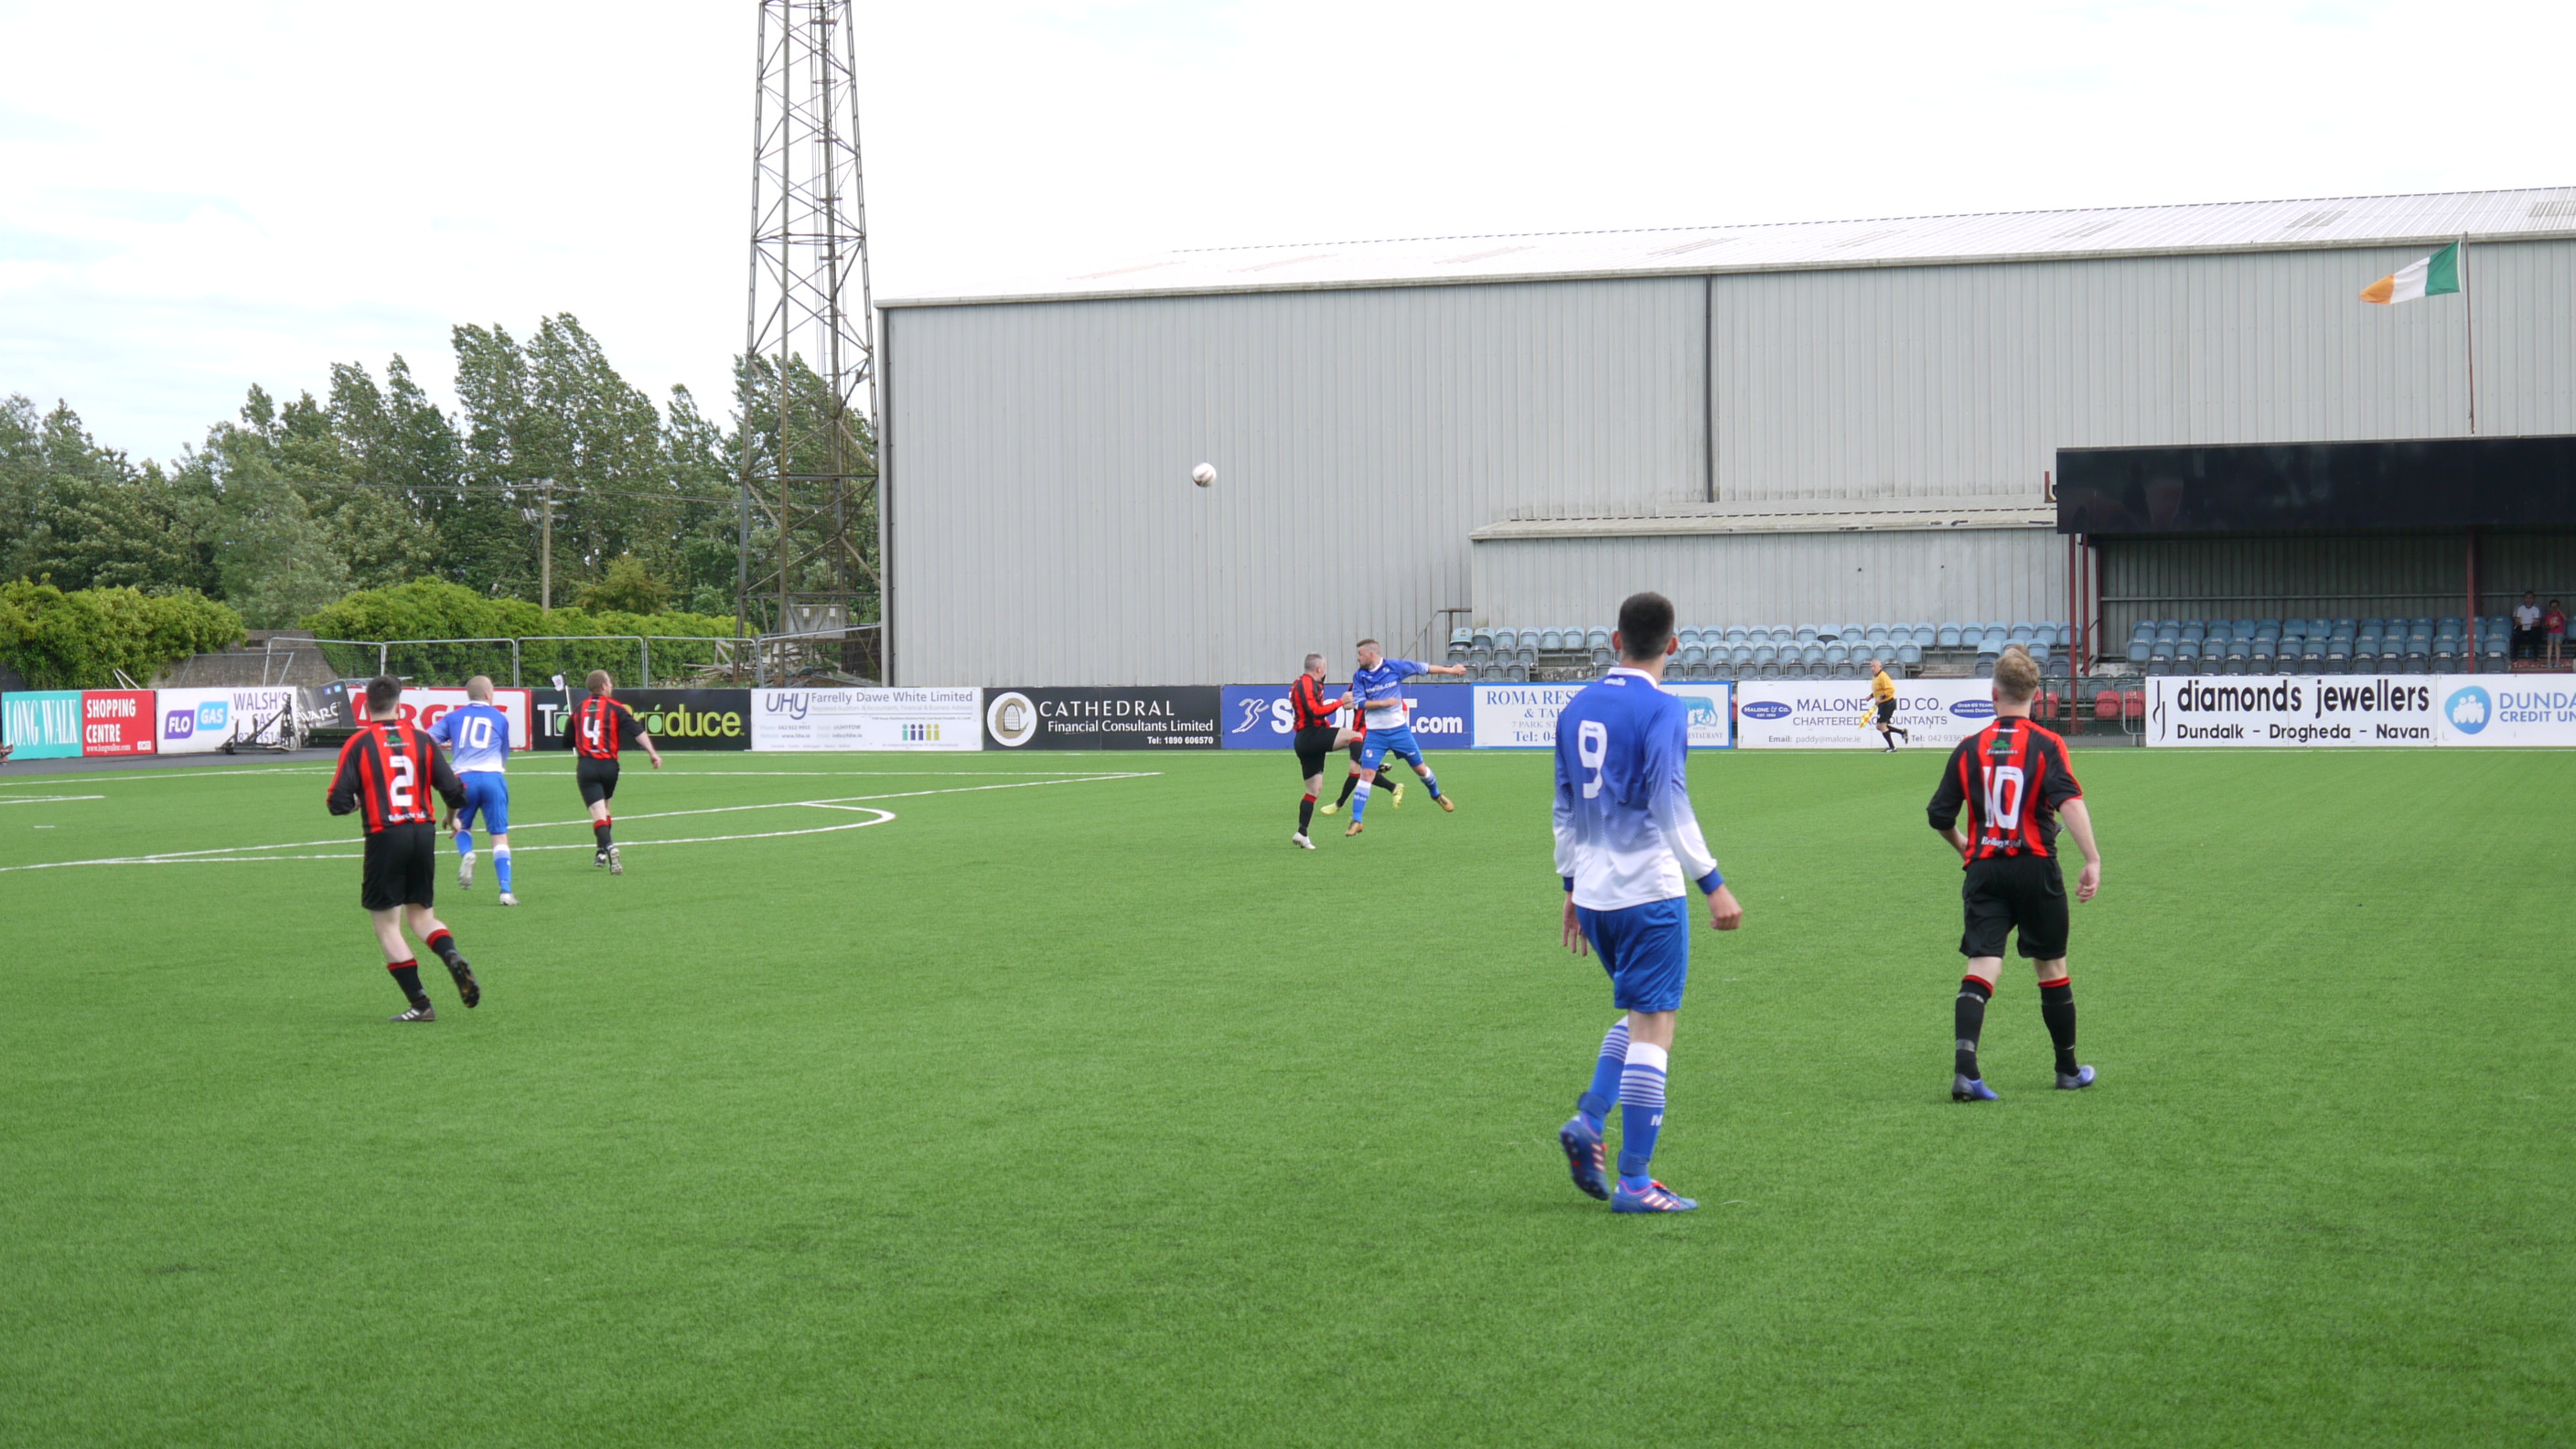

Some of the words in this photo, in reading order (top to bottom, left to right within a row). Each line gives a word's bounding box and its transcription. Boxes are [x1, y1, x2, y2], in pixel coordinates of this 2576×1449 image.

[811, 692, 852, 705] Farrelly
[856, 692, 889, 703] Dawe
[893, 691, 927, 703] White
[930, 691, 973, 703] Limited
[1487, 691, 1538, 705] ROMA
[1796, 698, 1868, 712] MALONE
[1915, 697, 1943, 712] CO.
[2177, 679, 2302, 712] diamonds
[2314, 679, 2430, 719] jewellers
[86, 698, 136, 718] SHOPPING
[200, 708, 224, 724] GAS
[1039, 700, 1175, 717] CATHEDRAL
[1524, 708, 1534, 718] &
[5, 700, 38, 746] LONG
[41, 699, 79, 745] WALK
[168, 716, 190, 734] FLO
[1792, 716, 1862, 726] CHARTERED
[2499, 711, 2551, 723] CREDIT
[86, 724, 121, 744] CENTRE
[458, 715, 492, 749] 10
[583, 716, 601, 746] 4
[1047, 719, 1099, 733] Financial
[1101, 719, 1167, 733] Consultants
[1170, 719, 1214, 732] Limited
[2176, 724, 2244, 739] Dundalk
[2270, 723, 2351, 743] Drogheda
[2376, 724, 2430, 739] Navan
[1147, 735, 1162, 745] Tel:
[1164, 735, 1183, 745] 1890
[1185, 735, 1214, 745] 606570
[1513, 731, 1539, 742] Tel:
[1768, 735, 1793, 743] Email:
[1796, 735, 1862, 745] paddy@malone.ie
[1578, 719, 1608, 800] 9
[390, 755, 414, 807] 2
[1981, 765, 2024, 830] 10
